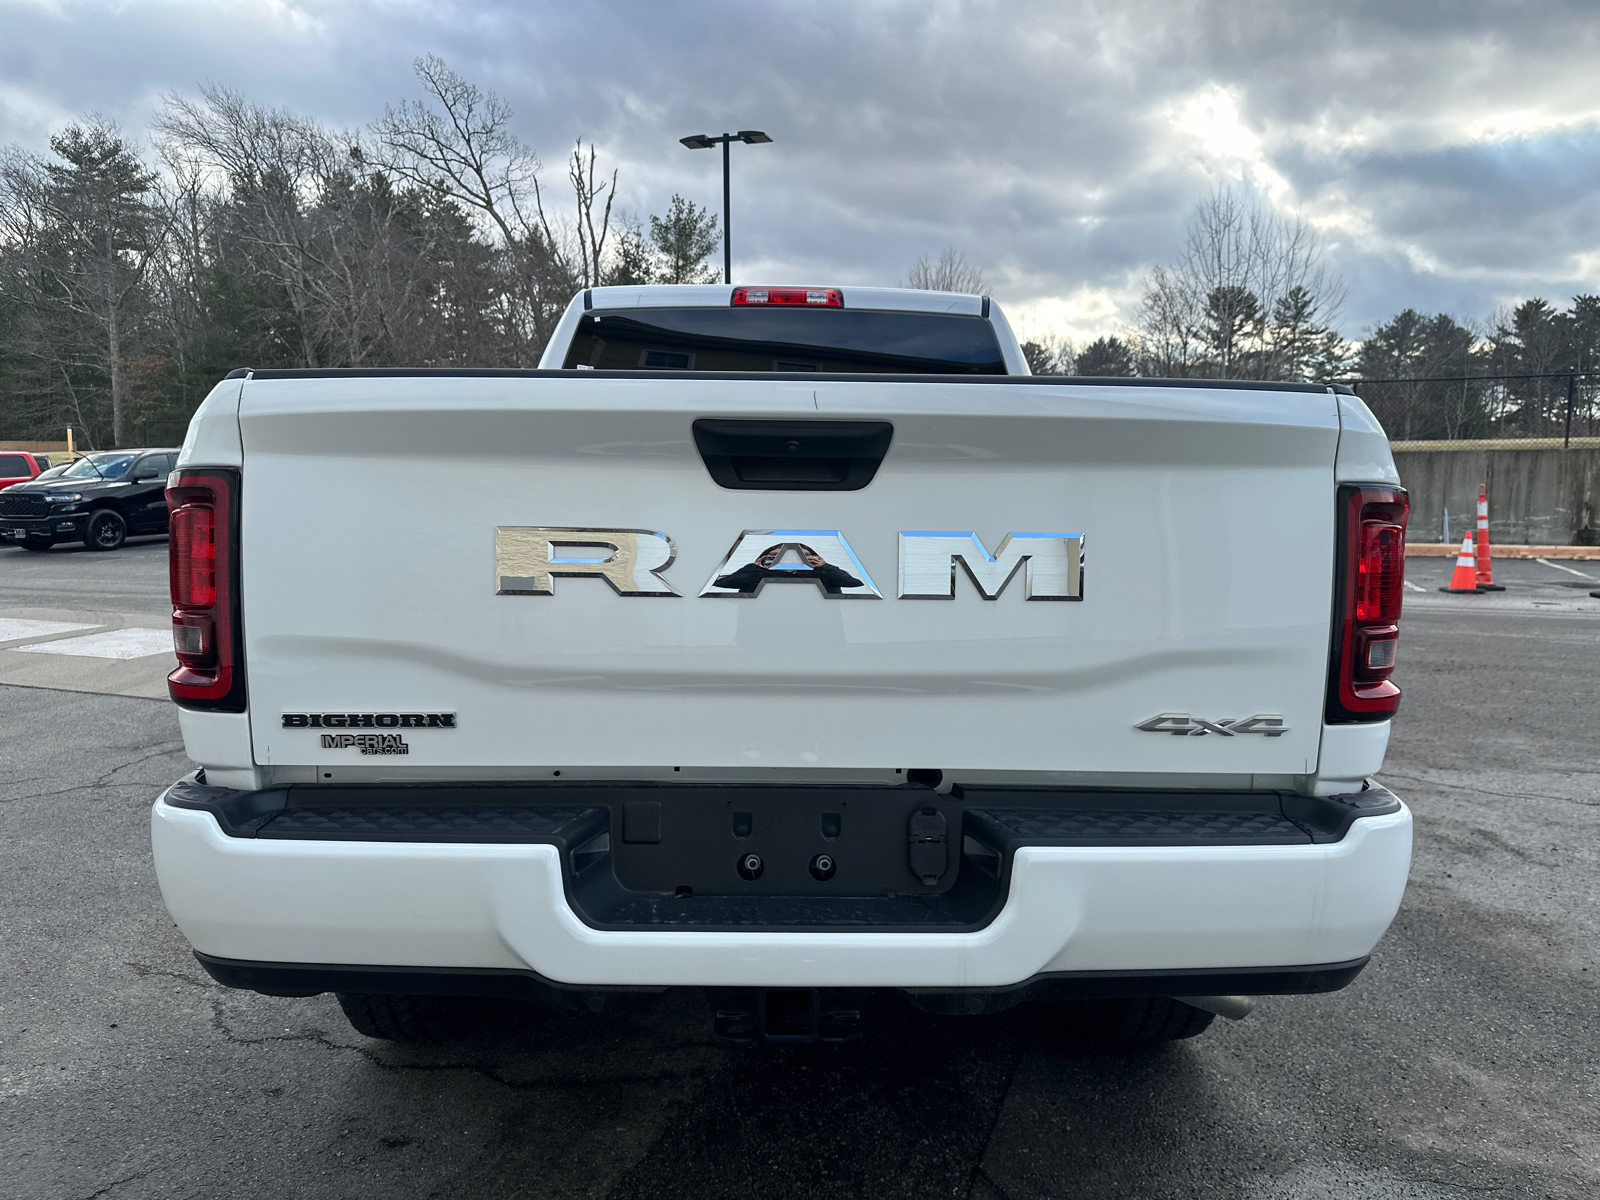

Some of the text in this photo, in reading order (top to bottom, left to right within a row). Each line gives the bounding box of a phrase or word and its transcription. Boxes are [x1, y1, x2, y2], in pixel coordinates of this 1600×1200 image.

[496, 526, 1085, 601] RAM
[282, 712, 456, 728] BIGHORN
[320, 734, 408, 749] IMPERIAL
[360, 746, 408, 755] cars.com
